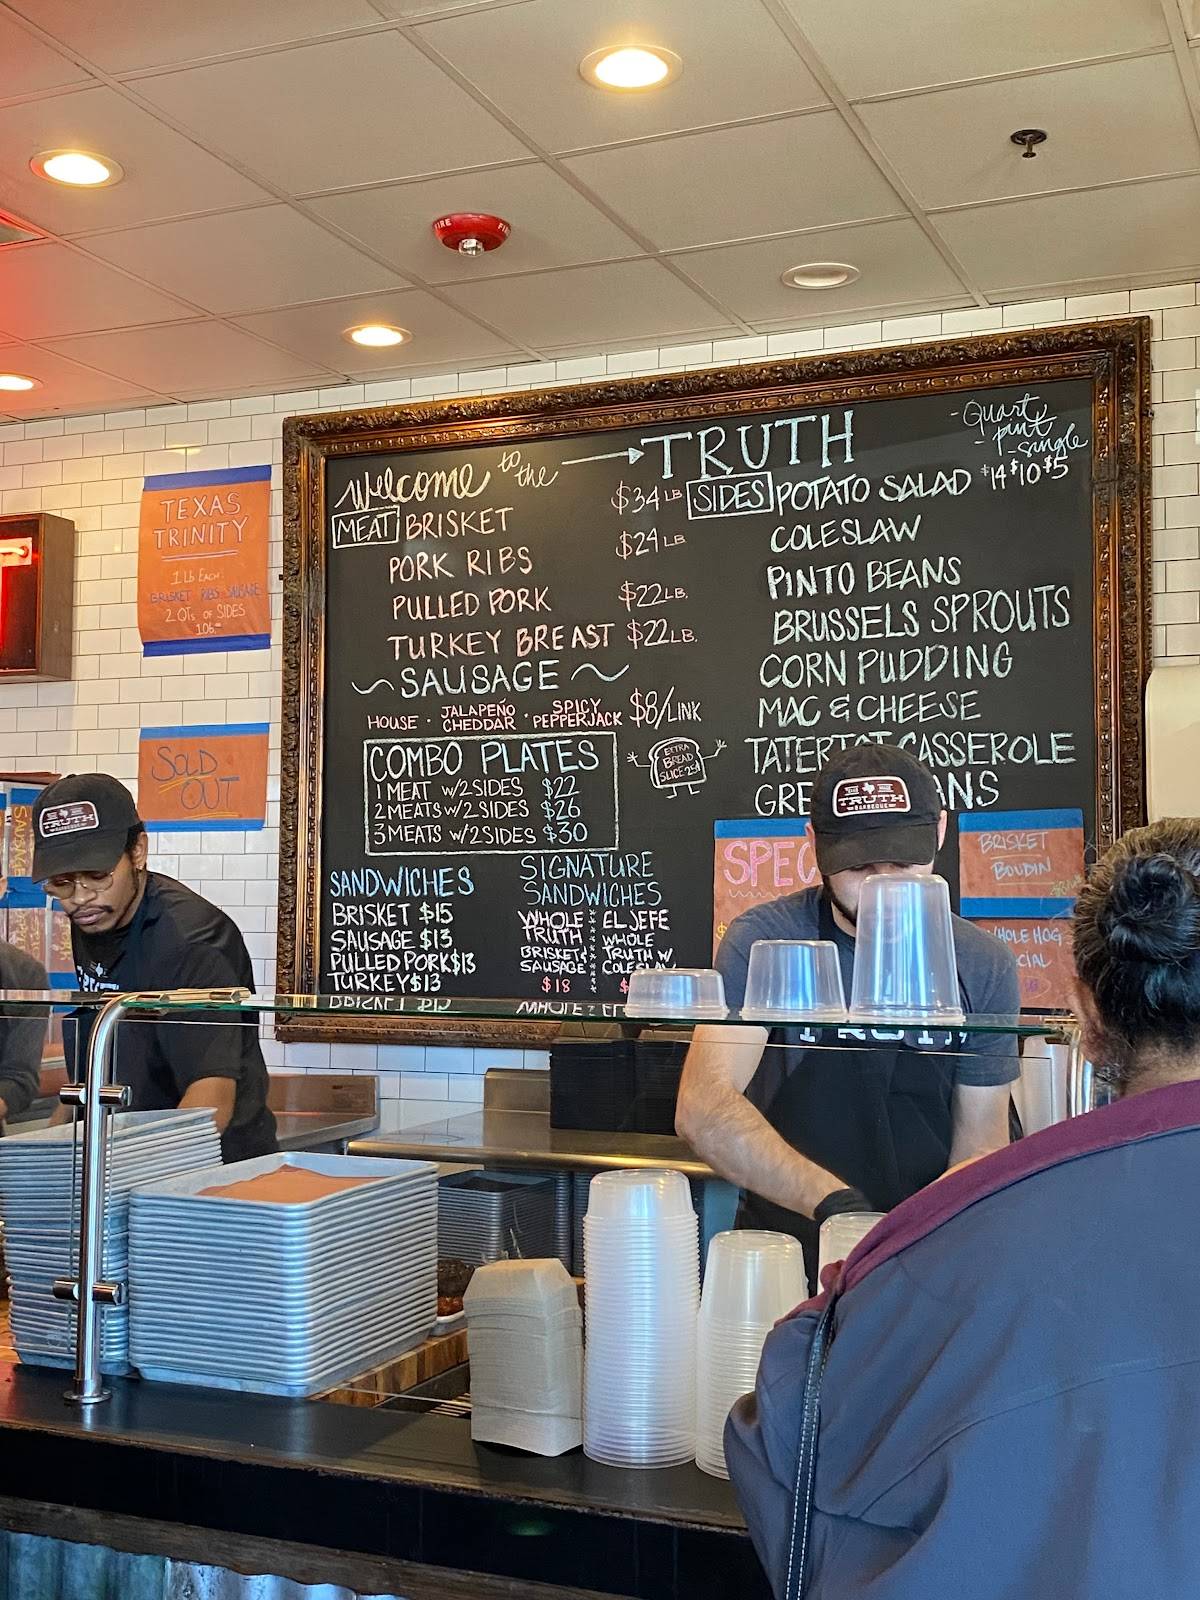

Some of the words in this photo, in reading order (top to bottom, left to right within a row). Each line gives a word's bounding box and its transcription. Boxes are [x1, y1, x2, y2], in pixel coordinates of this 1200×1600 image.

[334, 463, 491, 510] Welcome
[498, 450, 521, 473] to
[514, 461, 559, 488] the
[640, 410, 855, 480] TRUTH
[692, 479, 766, 513] SIDES
[775, 472, 872, 516] POTATO
[879, 468, 972, 502] SALAD
[980, 463, 1007, 491] $14
[1009, 457, 1041, 486] $10
[1042, 454, 1070, 480] $5
[160, 491, 242, 523] TEXAS
[337, 511, 398, 543] MEAT
[405, 507, 514, 541] BRISKET
[610, 480, 661, 515] $34
[153, 516, 249, 550] TRINITY
[770, 515, 922, 553] COLESLAW
[389, 552, 455, 585] PORK
[466, 546, 534, 577] RIBS
[615, 527, 660, 560] $24
[766, 564, 856, 600] PINTO
[867, 556, 962, 592] BEANS
[165, 608, 176, 622] 2
[217, 603, 246, 619] SIDES
[393, 590, 481, 621] PULLED
[489, 586, 552, 616] PORK
[773, 600, 920, 646] BRUSSELS
[931, 585, 1071, 635] SPROUTS
[387, 629, 502, 661] TURKEY
[516, 623, 616, 657] BREAST
[759, 650, 848, 689] CORN
[857, 640, 1014, 684] PUDDING
[400, 659, 561, 699] SAUSAGE
[552, 697, 601, 715] SPICY
[758, 696, 821, 729] MAC
[856, 690, 983, 723] CHEESE
[367, 715, 419, 730] HOUSE
[442, 717, 517, 733] CHEDDAR
[533, 711, 623, 729] PEPPERJACK
[369, 740, 463, 782] COMBO
[481, 739, 600, 775] PLATES
[663, 752, 694, 769] BREAD
[664, 743, 690, 756] EXTRA
[659, 765, 686, 782] SLICE
[180, 776, 240, 809] OUT
[387, 781, 431, 801] MEAT
[541, 775, 580, 800] $22
[754, 782, 811, 816] GRE
[387, 802, 442, 820] MEATS
[540, 799, 581, 823] $26
[838, 794, 904, 807] TRUTH
[43, 813, 94, 830] TRUTH
[387, 824, 442, 843] MEATS
[542, 821, 588, 844] $30
[978, 831, 1048, 854] BRISKET
[519, 851, 654, 880] SIGNATURE
[722, 841, 816, 887] SPEC
[991, 858, 1051, 880] BOUDIN
[330, 866, 475, 897] SANDWICHES
[522, 881, 662, 906] SANDWICHES
[332, 902, 411, 927] BRISKET
[418, 901, 454, 925] $15
[517, 908, 584, 930] WHOLE
[602, 910, 627, 929] EL
[629, 908, 671, 932] JEFE
[330, 929, 416, 952] SAUSAGE
[419, 927, 453, 950] $13
[521, 925, 583, 946] TRUTH
[602, 932, 655, 948] WHOLE
[988, 927, 1031, 945] HOLE
[1033, 927, 1063, 946] HOG
[330, 951, 401, 974] PULLED
[602, 945, 653, 962] TRUTH
[1015, 952, 1051, 969] CIAL
[519, 960, 587, 976] SAUSAGE
[541, 975, 571, 993] $18
